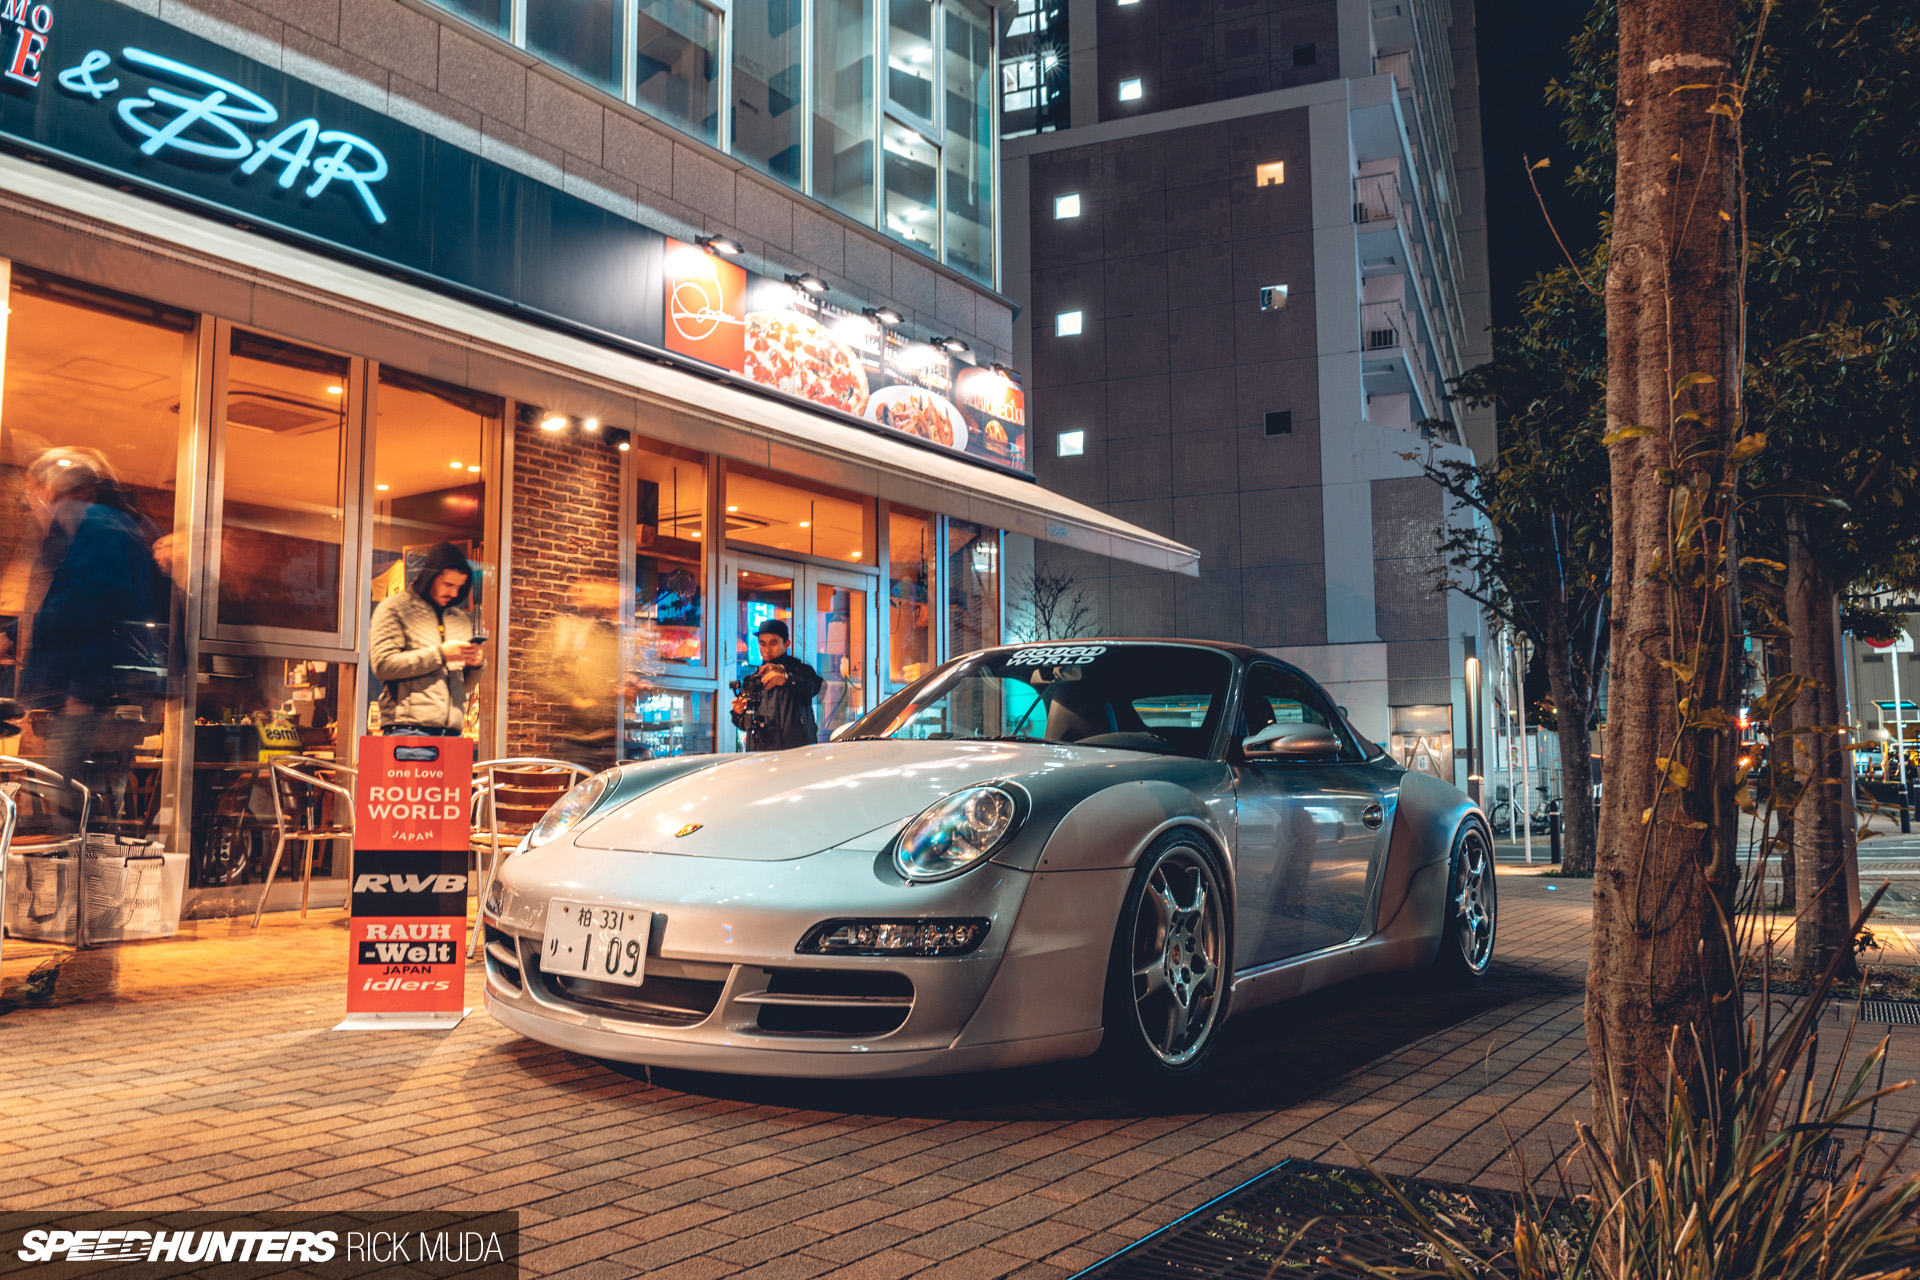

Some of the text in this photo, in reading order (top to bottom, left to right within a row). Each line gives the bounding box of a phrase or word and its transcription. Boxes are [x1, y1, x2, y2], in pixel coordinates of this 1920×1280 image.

[58, 46, 389, 224] & BAR
[1013, 646, 1107, 659] ROUGH
[1005, 656, 1095, 667] WORLD
[387, 768, 444, 778] one Love
[370, 787, 460, 802] ROUGH
[368, 804, 460, 820] WORLD
[392, 830, 434, 841] JAPAN
[353, 874, 467, 893] RWB
[600, 910, 624, 931] 331
[366, 924, 451, 940] RAUH
[365, 942, 451, 963] -Welt
[382, 965, 431, 975] JAPAN
[362, 978, 450, 991] idlers
